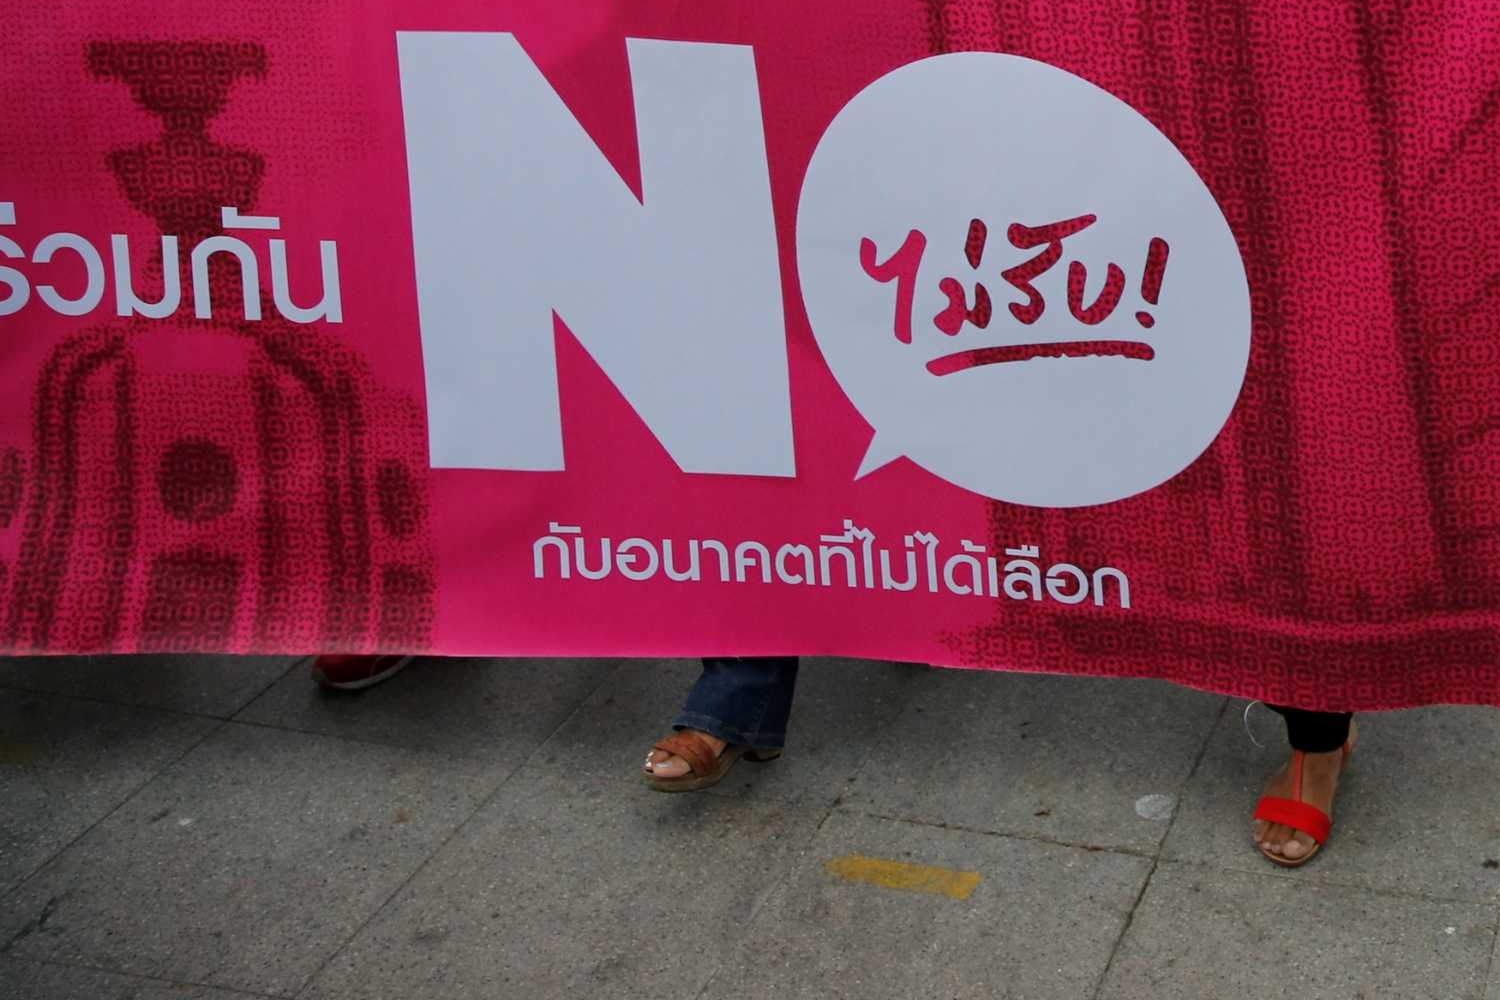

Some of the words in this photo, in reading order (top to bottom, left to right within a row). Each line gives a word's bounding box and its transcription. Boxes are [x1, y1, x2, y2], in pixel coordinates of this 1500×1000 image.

[859, 212, 1170, 346] ไม่รับ!
[532, 519, 1131, 609] กับอนาคตที่ไม่ได้เลือก
